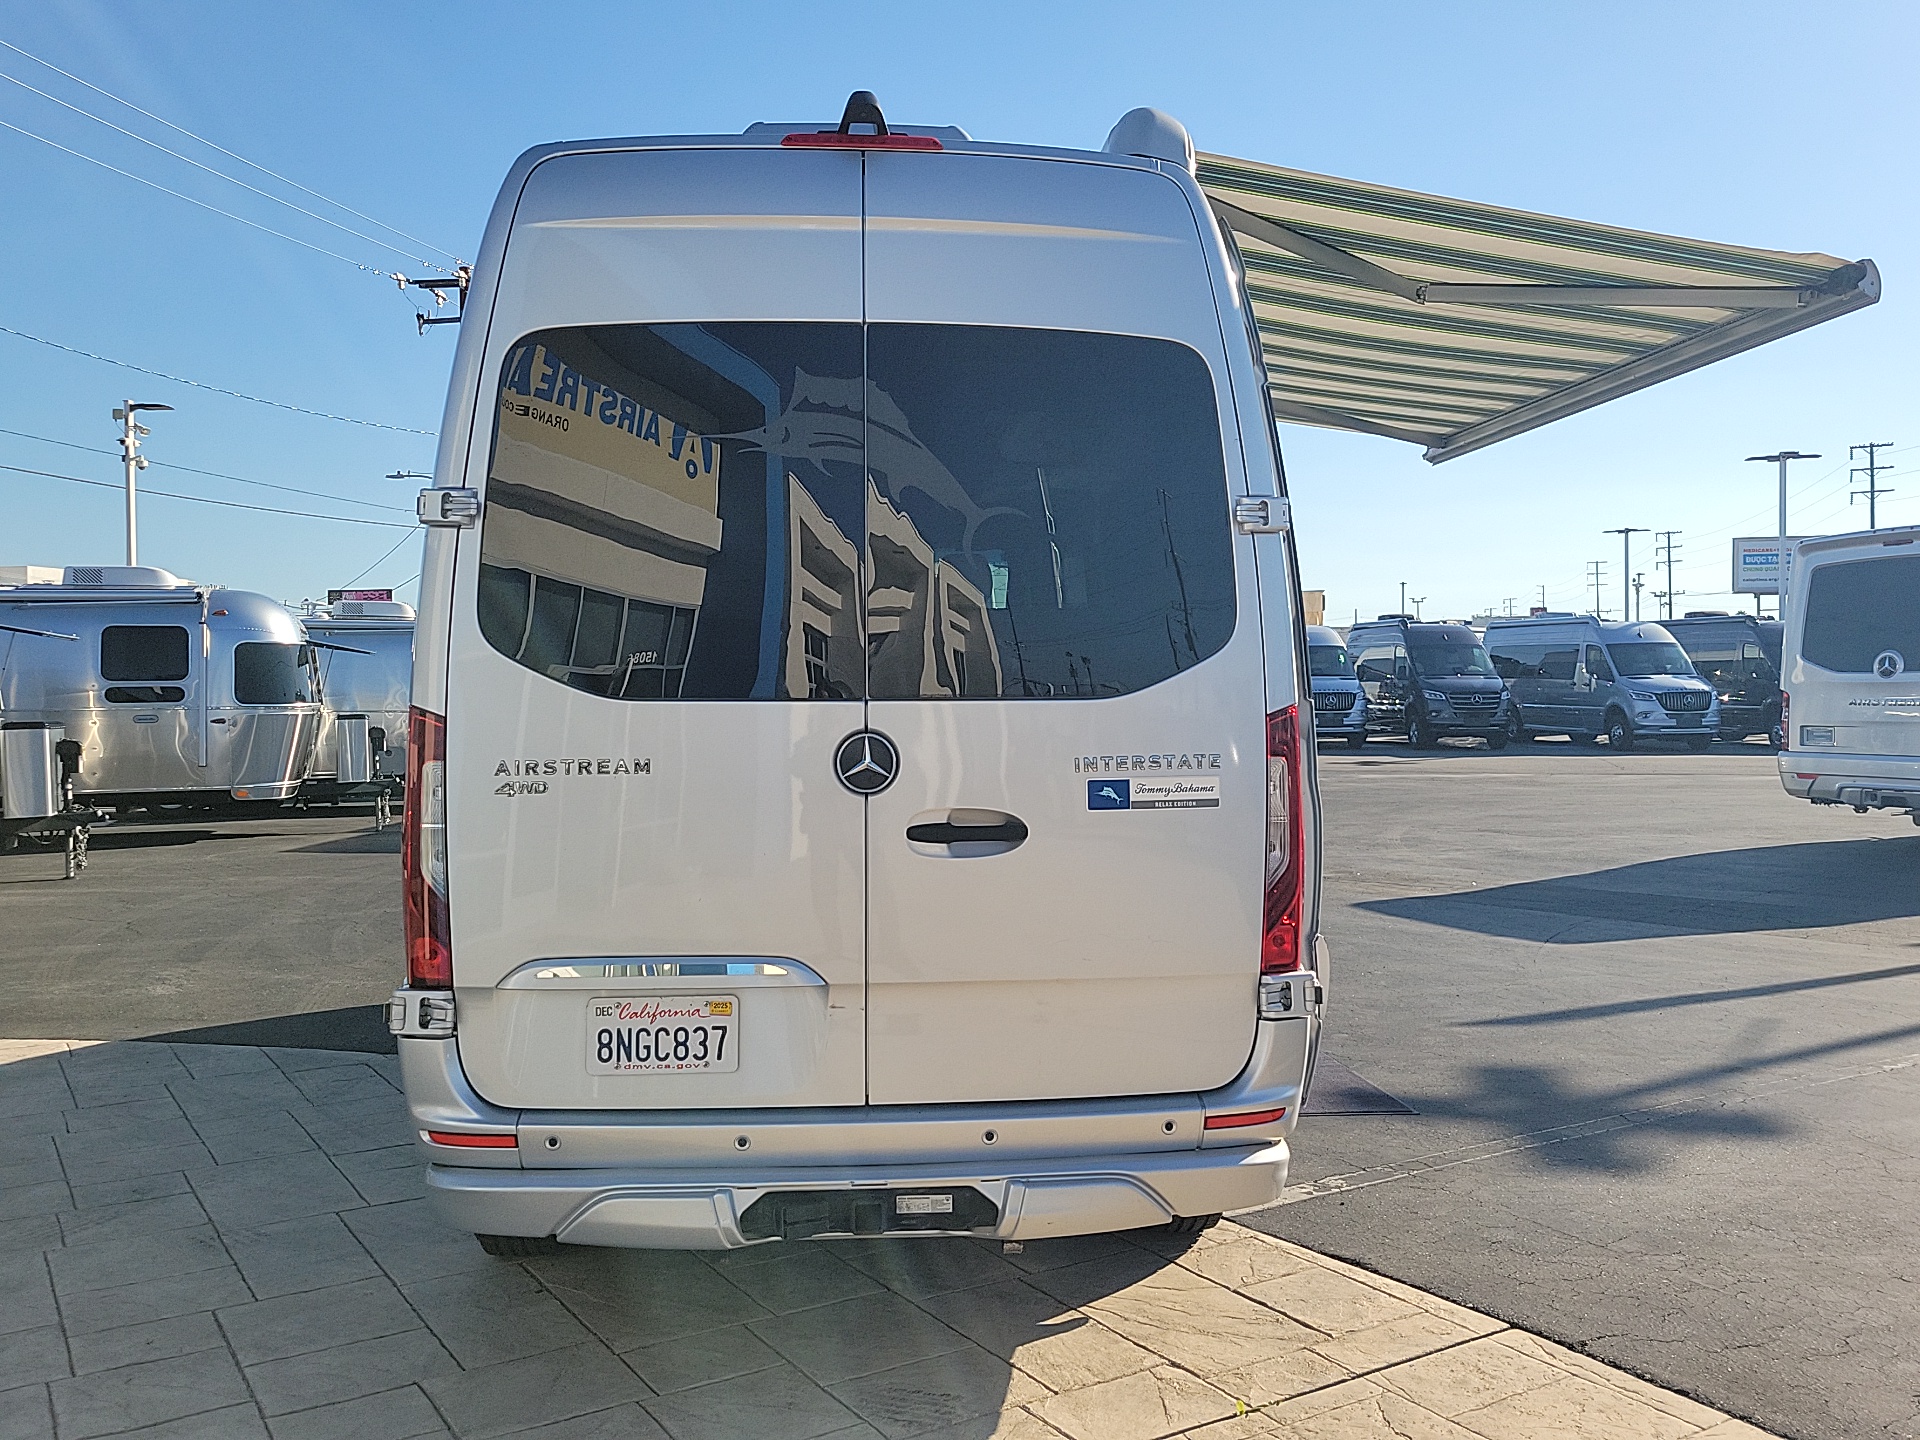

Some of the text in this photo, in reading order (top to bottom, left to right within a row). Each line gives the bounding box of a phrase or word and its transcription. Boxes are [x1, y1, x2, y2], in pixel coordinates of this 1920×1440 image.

[494, 758, 650, 776] AIRSTREAM
[1074, 753, 1221, 773] INTERSTATE
[494, 781, 549, 797] 4WD
[595, 1006, 613, 1017] DEC
[618, 1002, 711, 1025] California
[597, 1026, 727, 1063] 8NGC837
